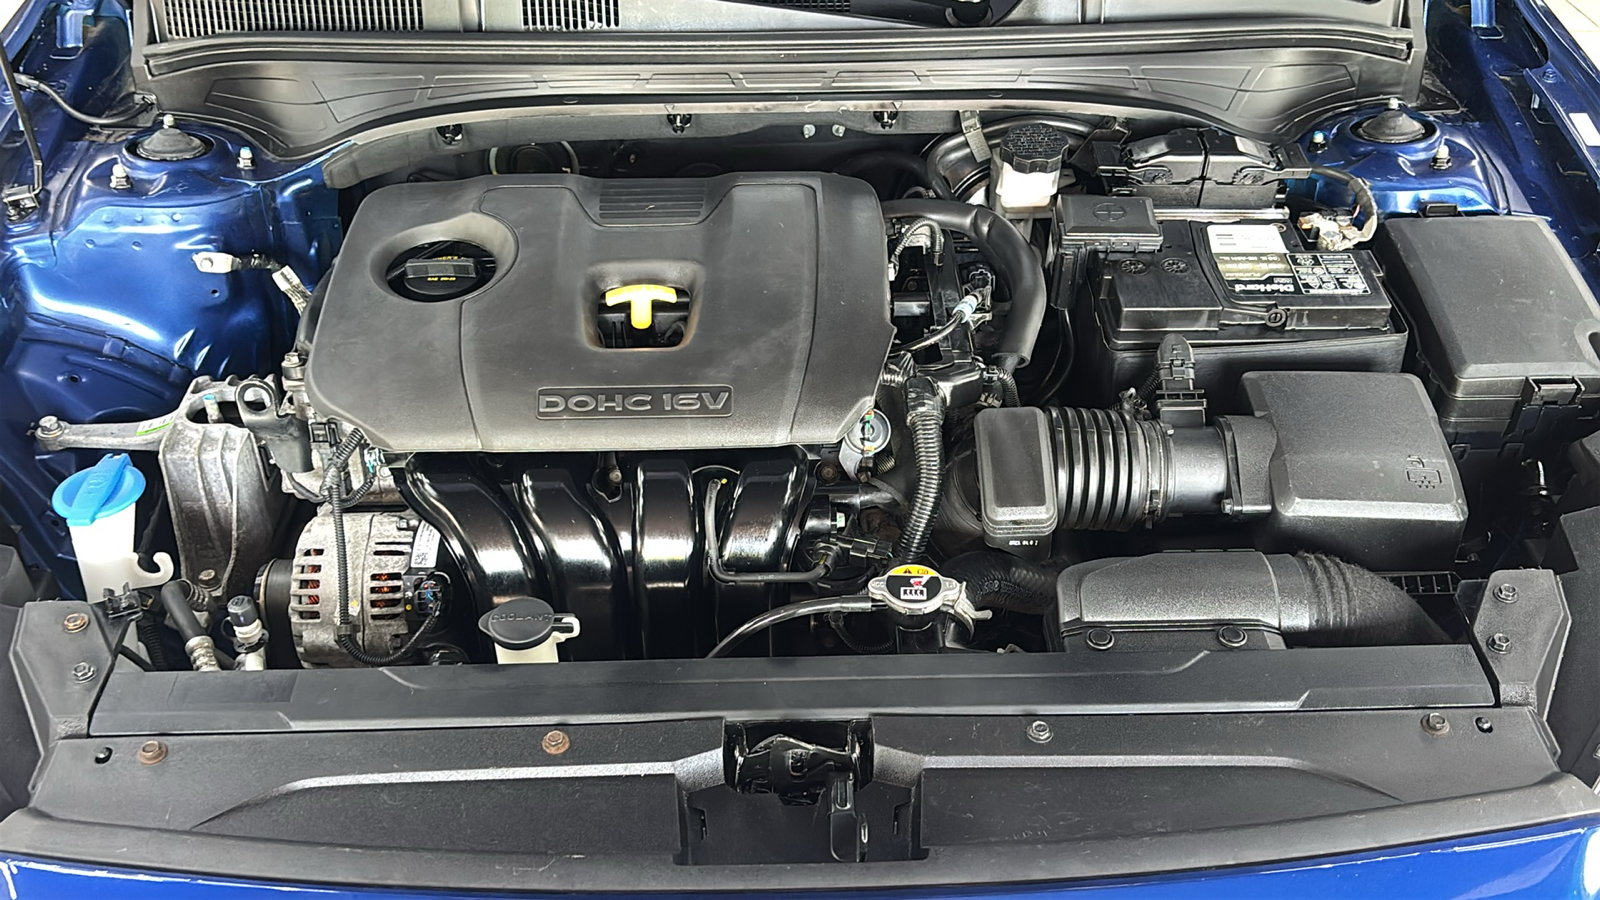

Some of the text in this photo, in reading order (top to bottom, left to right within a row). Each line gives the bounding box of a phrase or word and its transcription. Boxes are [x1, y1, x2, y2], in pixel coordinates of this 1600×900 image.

[1234, 283, 1295, 293] DieHard
[539, 391, 729, 413] DOHC 16V
[491, 613, 552, 622] COOLANT
